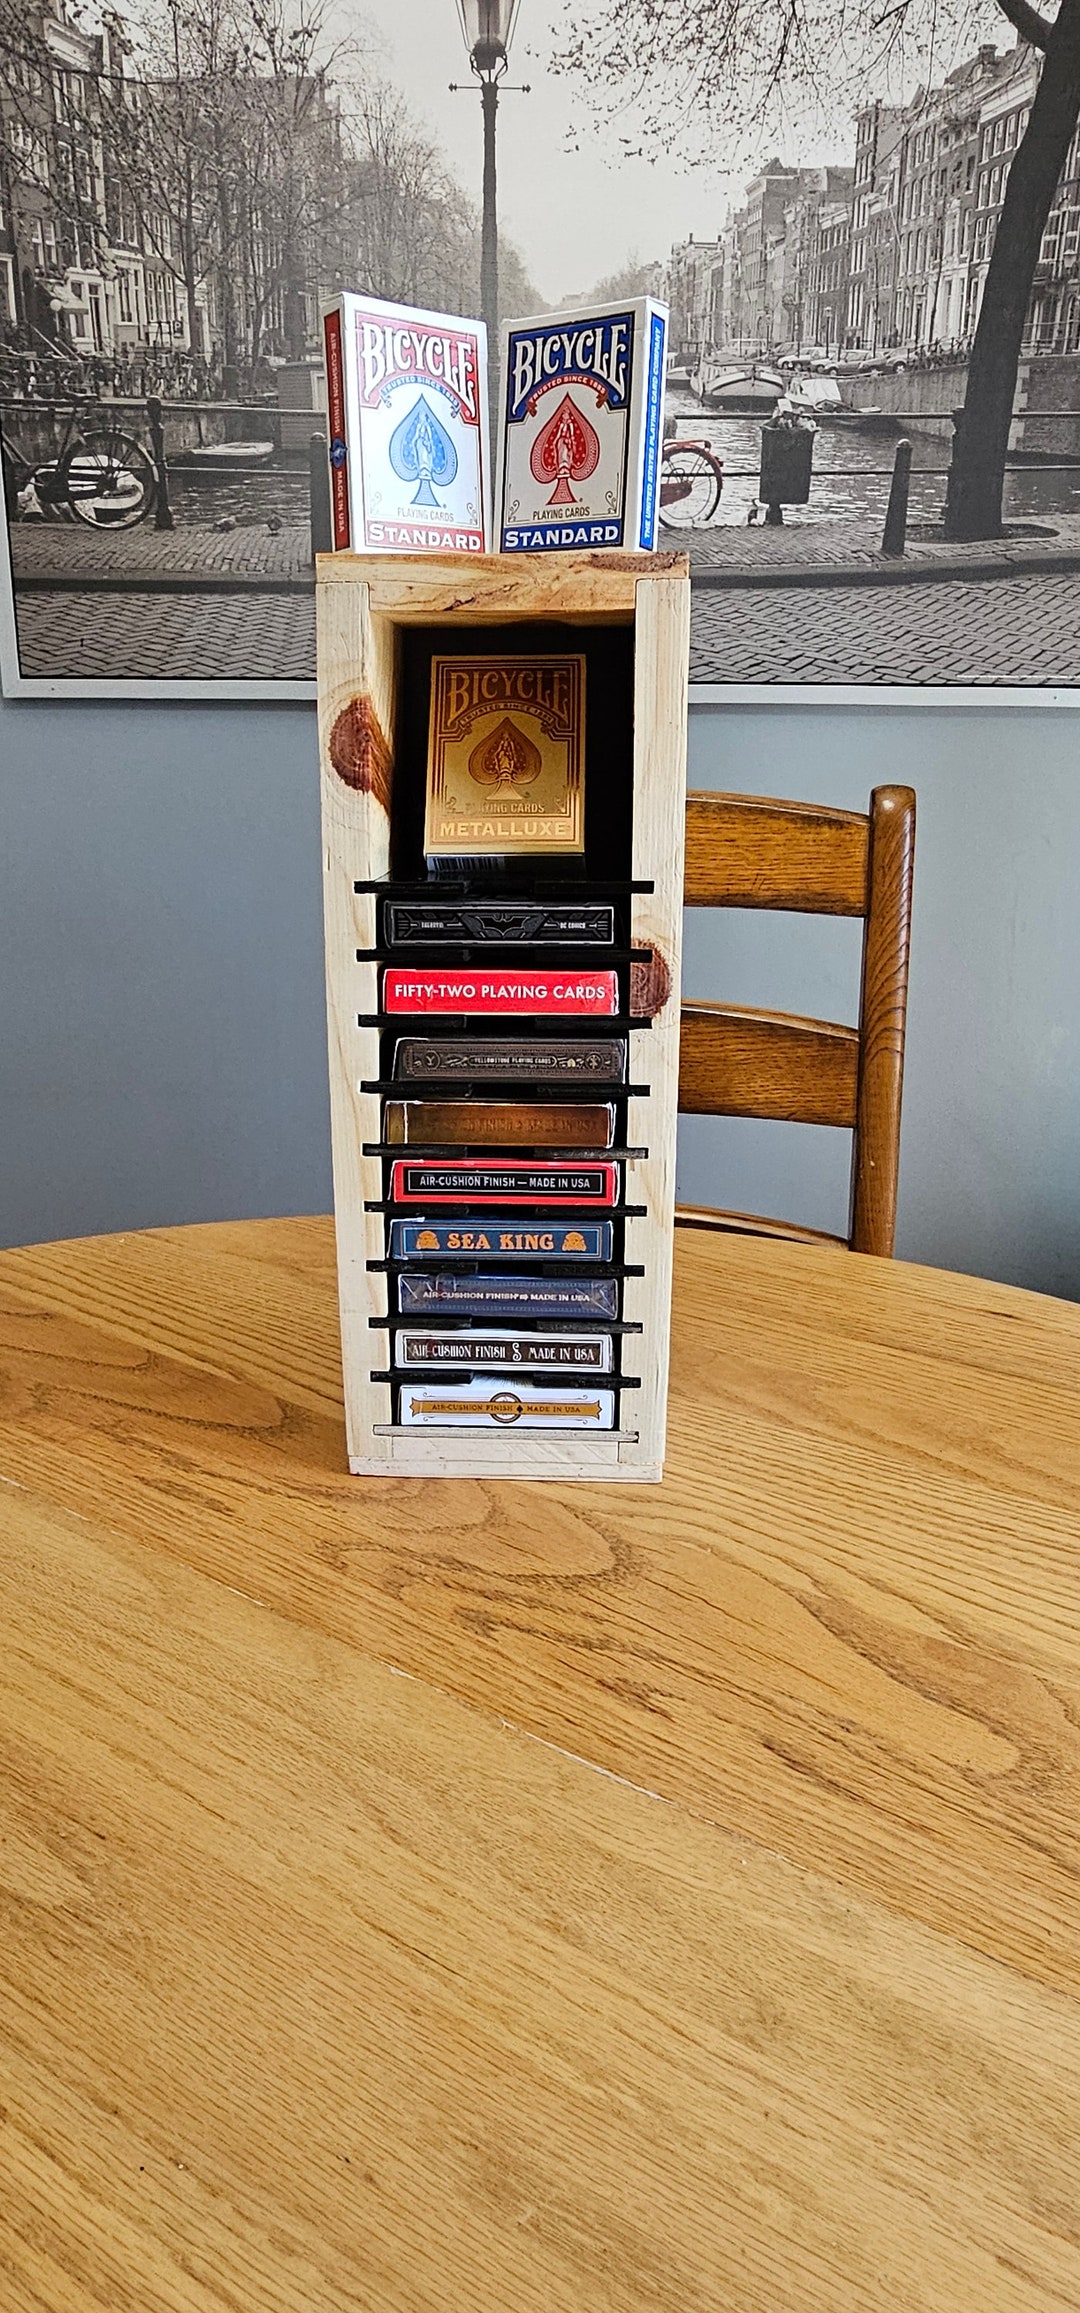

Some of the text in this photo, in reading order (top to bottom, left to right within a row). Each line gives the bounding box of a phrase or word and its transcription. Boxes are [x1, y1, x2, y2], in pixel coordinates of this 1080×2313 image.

[653, 326, 661, 376] COMPANY
[330, 332, 339, 398] AIR-CUSHION
[361, 321, 476, 419] BICYCLE
[512, 323, 627, 416] BICYCLE
[381, 376, 416, 396] TRUSTED
[417, 376, 441, 391] SINCE
[529, 378, 562, 402] TRUSTED
[563, 375, 588, 385] SINCE
[651, 375, 659, 404] CARD
[333, 399, 341, 433] FINISH
[649, 404, 657, 446] PLAYING
[647, 447, 655, 483] STATES
[338, 499, 344, 510] IN
[645, 483, 653, 519] UNITED
[397, 506, 455, 522] PLAYING CARDS
[532, 506, 590, 521] PLAYING CARDS
[369, 523, 481, 551] STANDARD
[505, 525, 619, 548] STANDARD
[447, 670, 569, 727] BICYCLE
[510, 802, 545, 814] CARDS
[440, 821, 567, 837] METALLUXE
[394, 984, 606, 999] FIFTY-TWO PLAYING CARDS
[419, 1175, 481, 1187] AIR-CUSHION
[483, 1176, 515, 1188] FINISH
[529, 1177, 556, 1188] MADE
[558, 1177, 568, 1188] IN
[571, 1177, 591, 1188] USA
[446, 1233, 554, 1250] SEA KING
[423, 1291, 484, 1300] AIR-CUSHION
[530, 1293, 557, 1301] MADE
[558, 1293, 569, 1301] IN
[571, 1294, 590, 1302] USA
[412, 1344, 595, 1361] AIR-CUSHION FINISH MADE IN USA
[485, 1404, 513, 1412] FINISH
